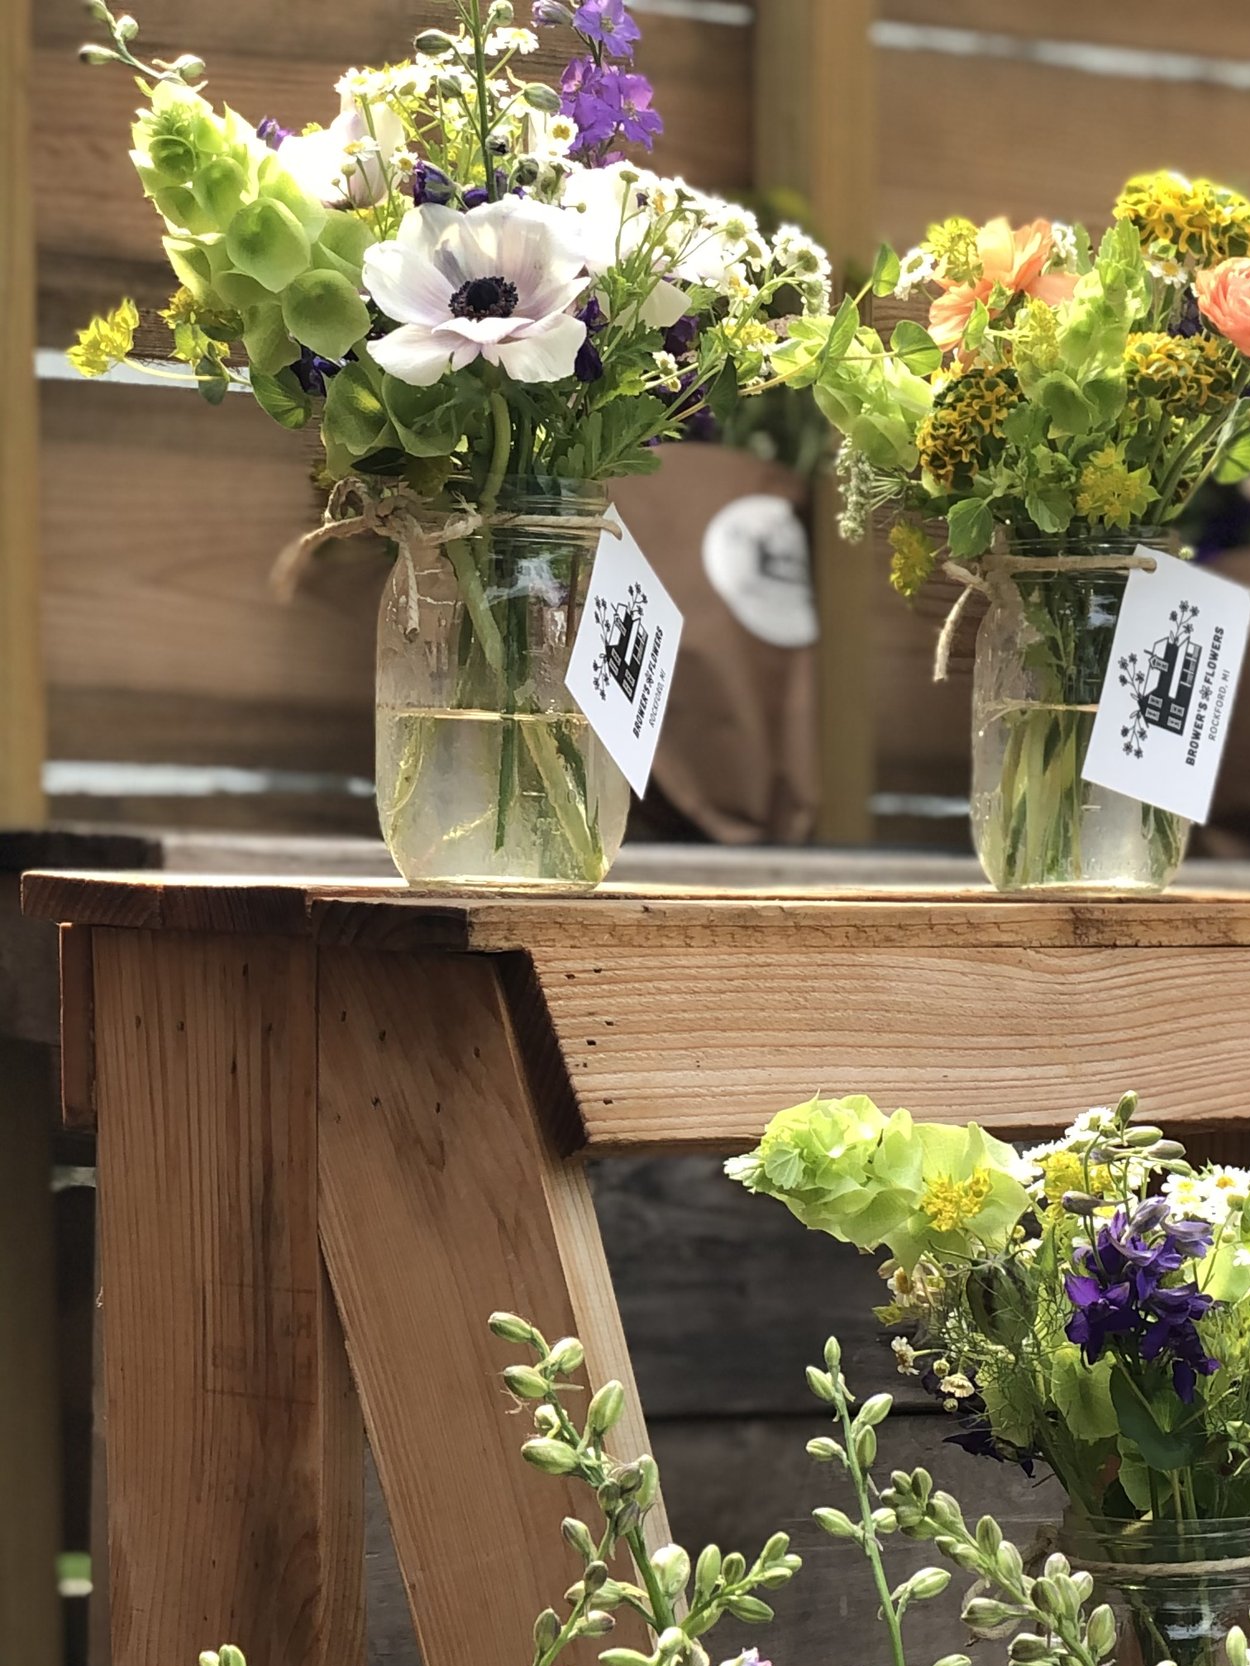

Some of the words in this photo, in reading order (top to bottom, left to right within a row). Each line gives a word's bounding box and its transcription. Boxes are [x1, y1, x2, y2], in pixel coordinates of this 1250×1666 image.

[632, 683, 650, 739] BROWER'S
[648, 625, 663, 675] FLOWERS
[1185, 701, 1208, 766] BROWER'S
[1204, 626, 1224, 685] FLOWERS
[1208, 684, 1229, 741] ROCKFORD,
